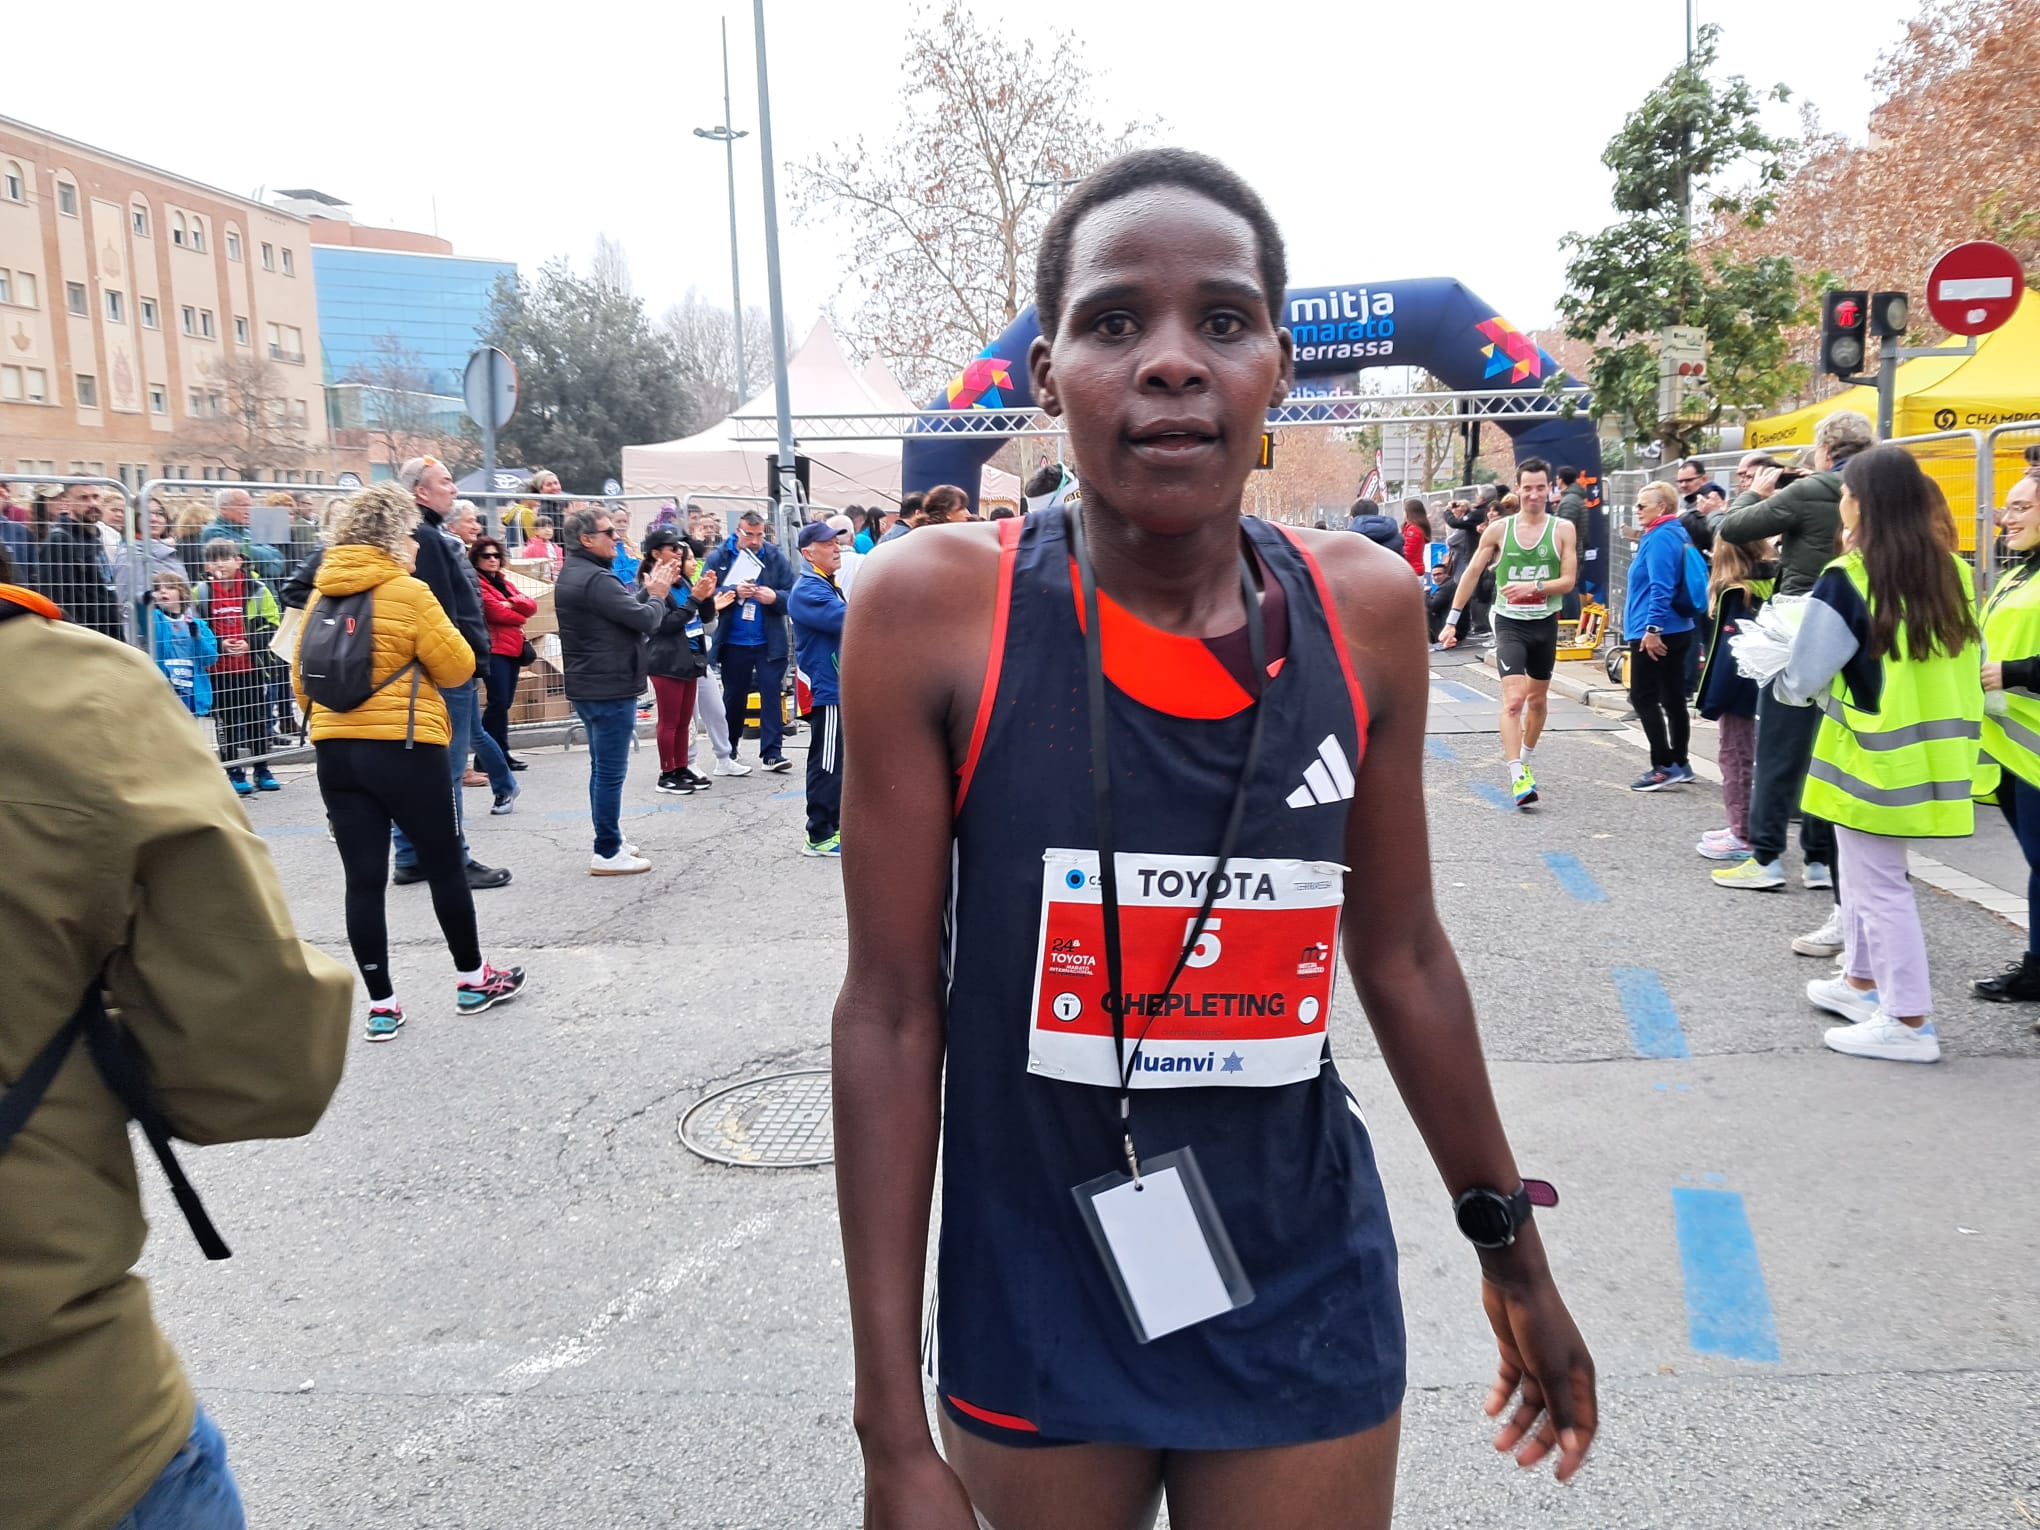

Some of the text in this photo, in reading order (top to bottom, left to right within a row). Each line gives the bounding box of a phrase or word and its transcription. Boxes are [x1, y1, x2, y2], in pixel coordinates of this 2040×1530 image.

[1291, 288, 1394, 325] mitja
[1292, 314, 1395, 343] marató
[1292, 340, 1394, 362] terrassa
[1508, 564, 1551, 580] LEA
[1138, 868, 1276, 901] TOYOTA
[1181, 917, 1222, 968] 5
[1051, 952, 1096, 966] TOYOTA
[1062, 1002, 1070, 1016] 1
[1101, 992, 1285, 1016] CHEPLETING
[1135, 1051, 1215, 1072] luanvi
